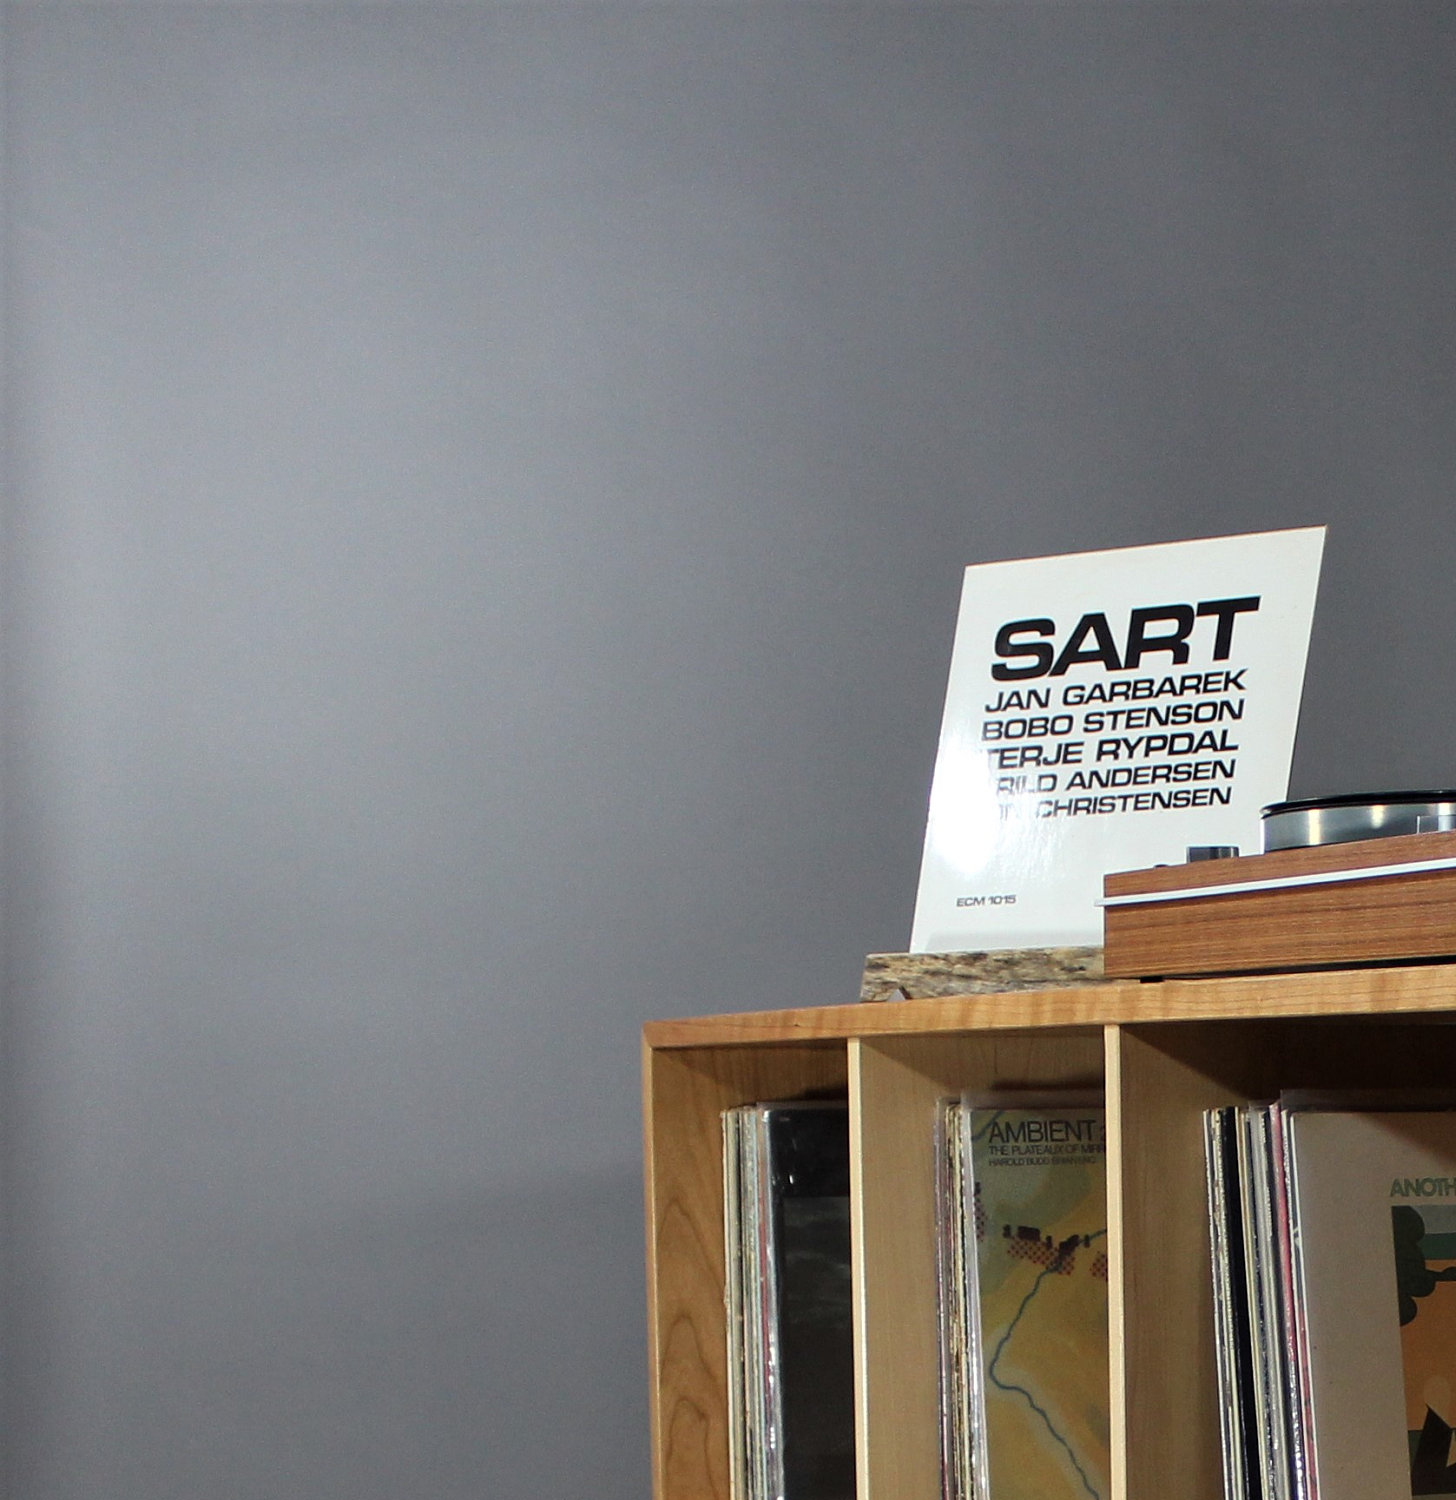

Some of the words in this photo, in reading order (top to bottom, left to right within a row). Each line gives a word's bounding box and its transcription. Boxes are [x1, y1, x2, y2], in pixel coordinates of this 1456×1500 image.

[990, 595, 1261, 682] SART
[985, 688, 1051, 713] JAN
[1062, 668, 1248, 707] GARBAREK
[981, 714, 1074, 742] BOBO
[1082, 698, 1245, 733] STENSON
[1096, 729, 1239, 763] RYPDAL
[1065, 759, 1236, 791] ANDERSEN
[1036, 786, 1232, 818] CHRISTENSEN
[956, 896, 986, 907] ECM
[988, 894, 1017, 905] 1015
[989, 1120, 1096, 1142] AMBIENT
